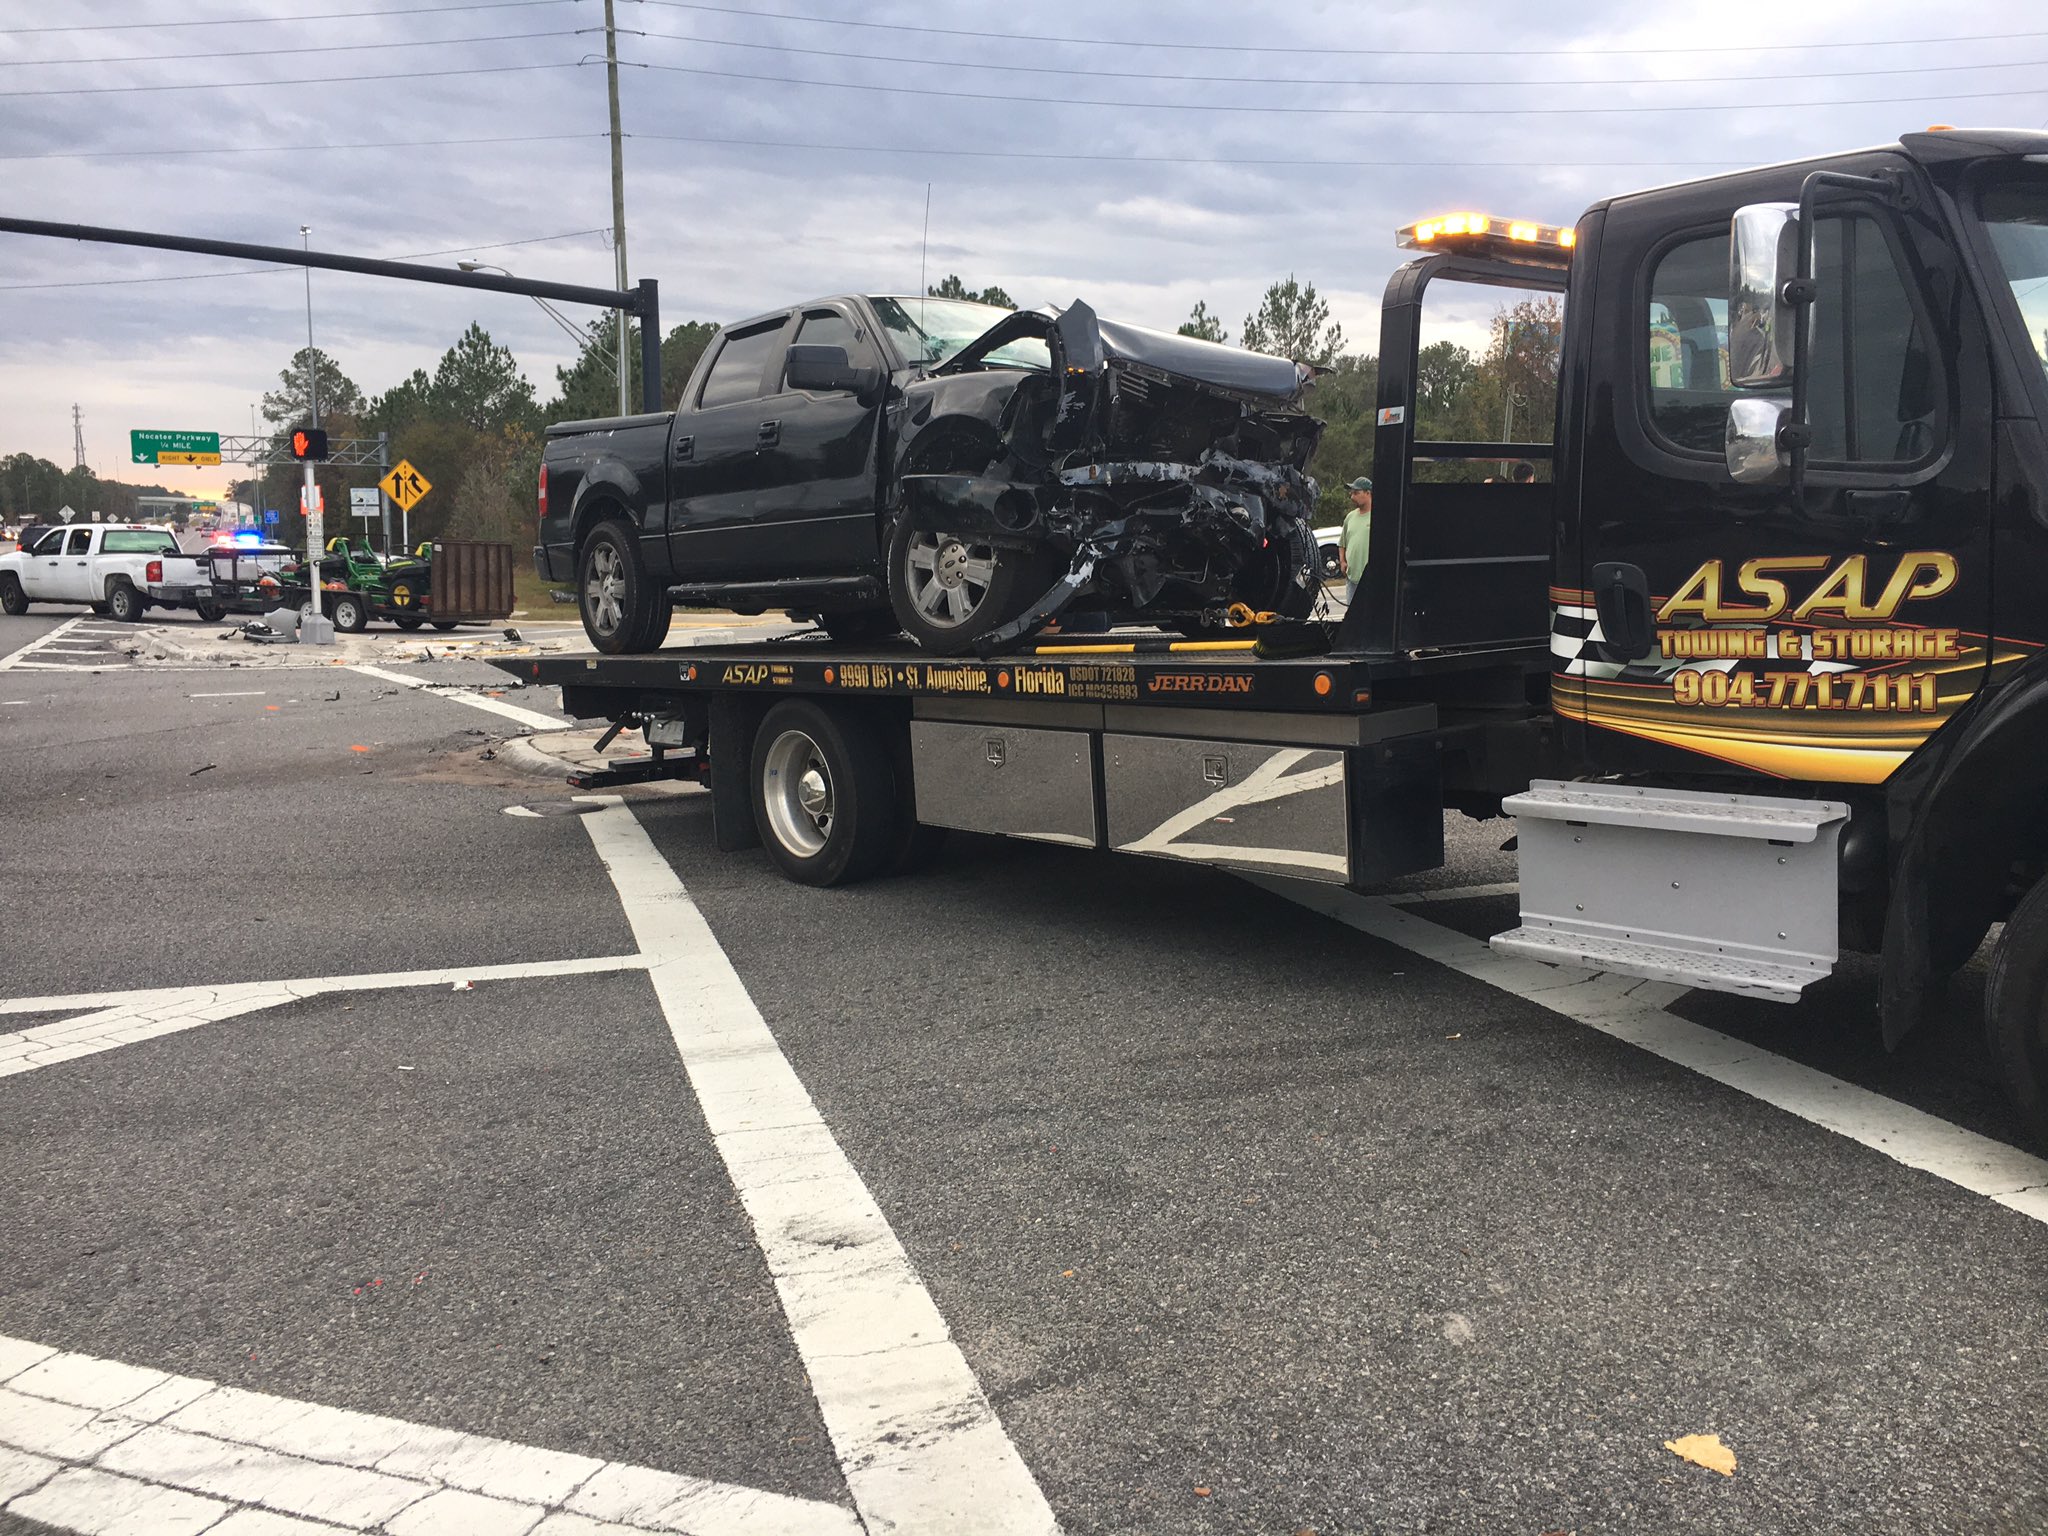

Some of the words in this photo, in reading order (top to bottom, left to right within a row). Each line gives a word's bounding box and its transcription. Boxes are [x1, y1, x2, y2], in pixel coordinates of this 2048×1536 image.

[176, 434, 211, 442] Parkway
[1656, 551, 1959, 622] ASAP
[1657, 628, 1767, 660] TOWING
[1778, 628, 1802, 660] &
[1812, 628, 1961, 661] STORAGE
[722, 664, 768, 684] ASAP
[840, 665, 869, 688] 9990
[906, 665, 922, 689] St.
[926, 665, 991, 694] Augustine,
[1014, 666, 1065, 694] Florida
[1069, 666, 1099, 681] USDOT
[1101, 667, 1135, 682] 721828
[1068, 683, 1084, 697] ICC
[1673, 669, 1937, 713] 904.771.7111
